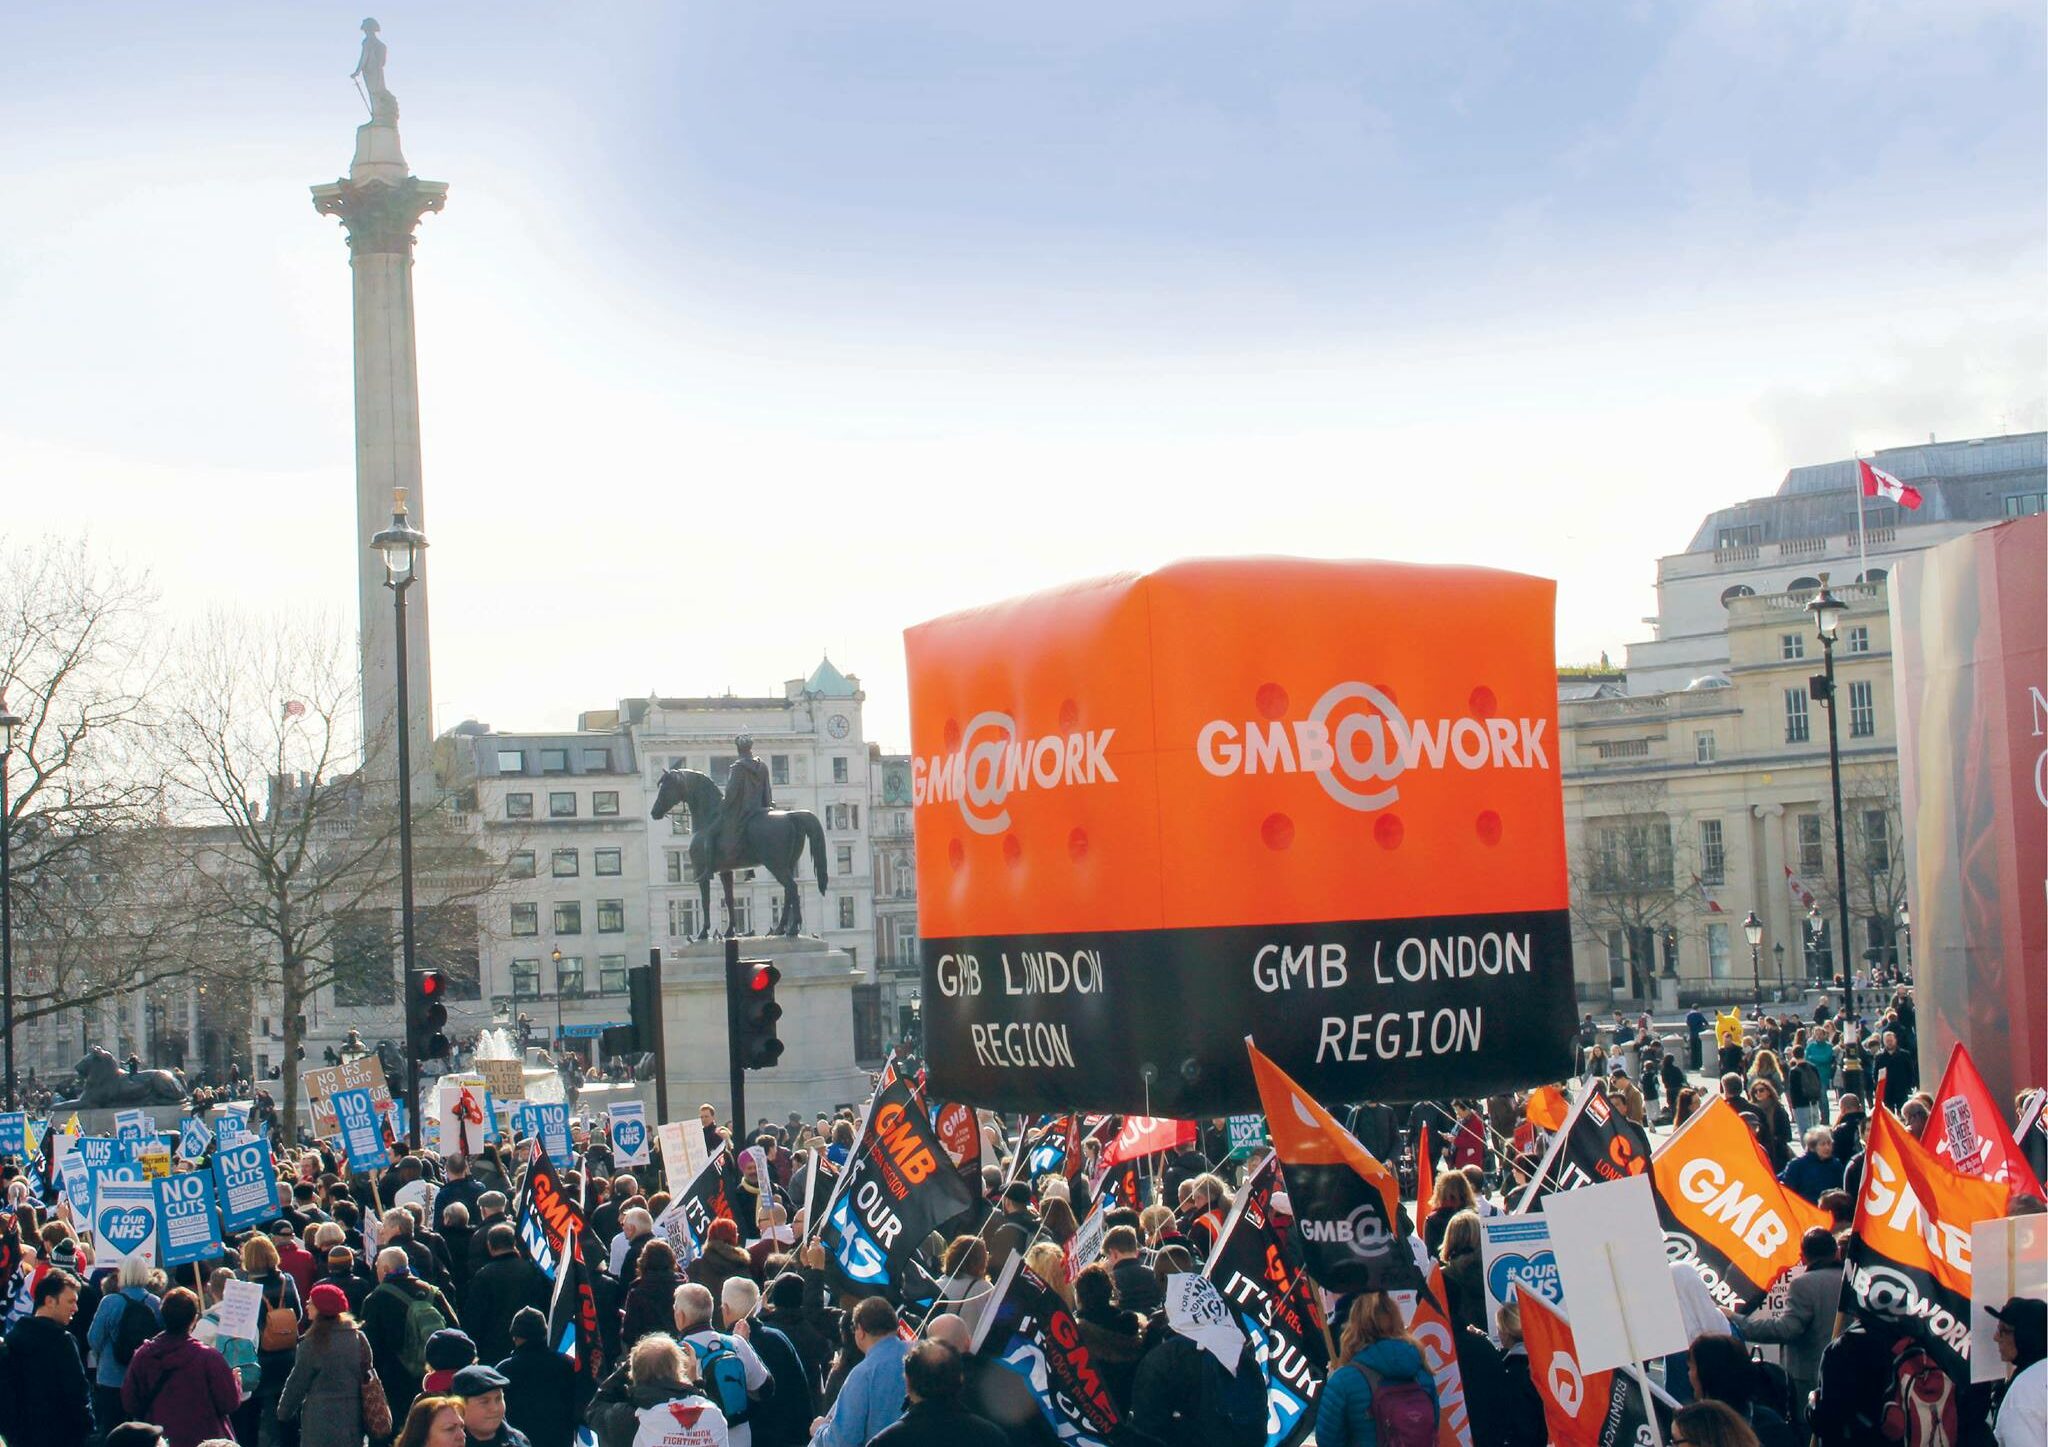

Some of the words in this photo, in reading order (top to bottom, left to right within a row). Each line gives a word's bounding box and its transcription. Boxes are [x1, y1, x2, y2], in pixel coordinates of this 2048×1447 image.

[1197, 681, 1550, 811] GMB@WORK
[911, 711, 1119, 835] GMB@WORK
[937, 954, 982, 997] GMB
[1003, 950, 1103, 995] LONDON
[1253, 944, 1347, 992] GMB
[1373, 932, 1531, 986] LONDON
[971, 1022, 1075, 1068] REGION
[1315, 1006, 1482, 1064] REGION
[317, 1071, 336, 1087] NO
[341, 1062, 361, 1076] IFS
[320, 1083, 339, 1096] NO
[344, 1071, 372, 1088] BUTS
[338, 1093, 367, 1117] NO
[541, 1107, 564, 1124] NO
[218, 1119, 238, 1132] NO
[345, 1112, 371, 1129] CUTS
[544, 1123, 566, 1135] CUTS
[625, 1126, 639, 1134] OUR
[943, 1107, 968, 1136] GMB
[1230, 1123, 1262, 1139] NOT
[86, 1141, 111, 1160] NHS
[620, 1133, 641, 1146] NHS
[875, 1103, 937, 1184] GMB
[220, 1147, 260, 1176] NO
[226, 1167, 264, 1187] CUTS
[161, 1176, 203, 1204] NO
[121, 1215, 145, 1224] OUR
[165, 1199, 206, 1217] CUTS
[857, 1181, 903, 1250] OUR
[1679, 1158, 1788, 1259] GMB
[108, 1225, 145, 1239] NHS
[168, 1214, 207, 1228] CLOSURES
[1521, 1264, 1557, 1280] OUR
[1223, 1270, 1273, 1328] IT'S
[663, 1436, 701, 1445] FIGHTING
